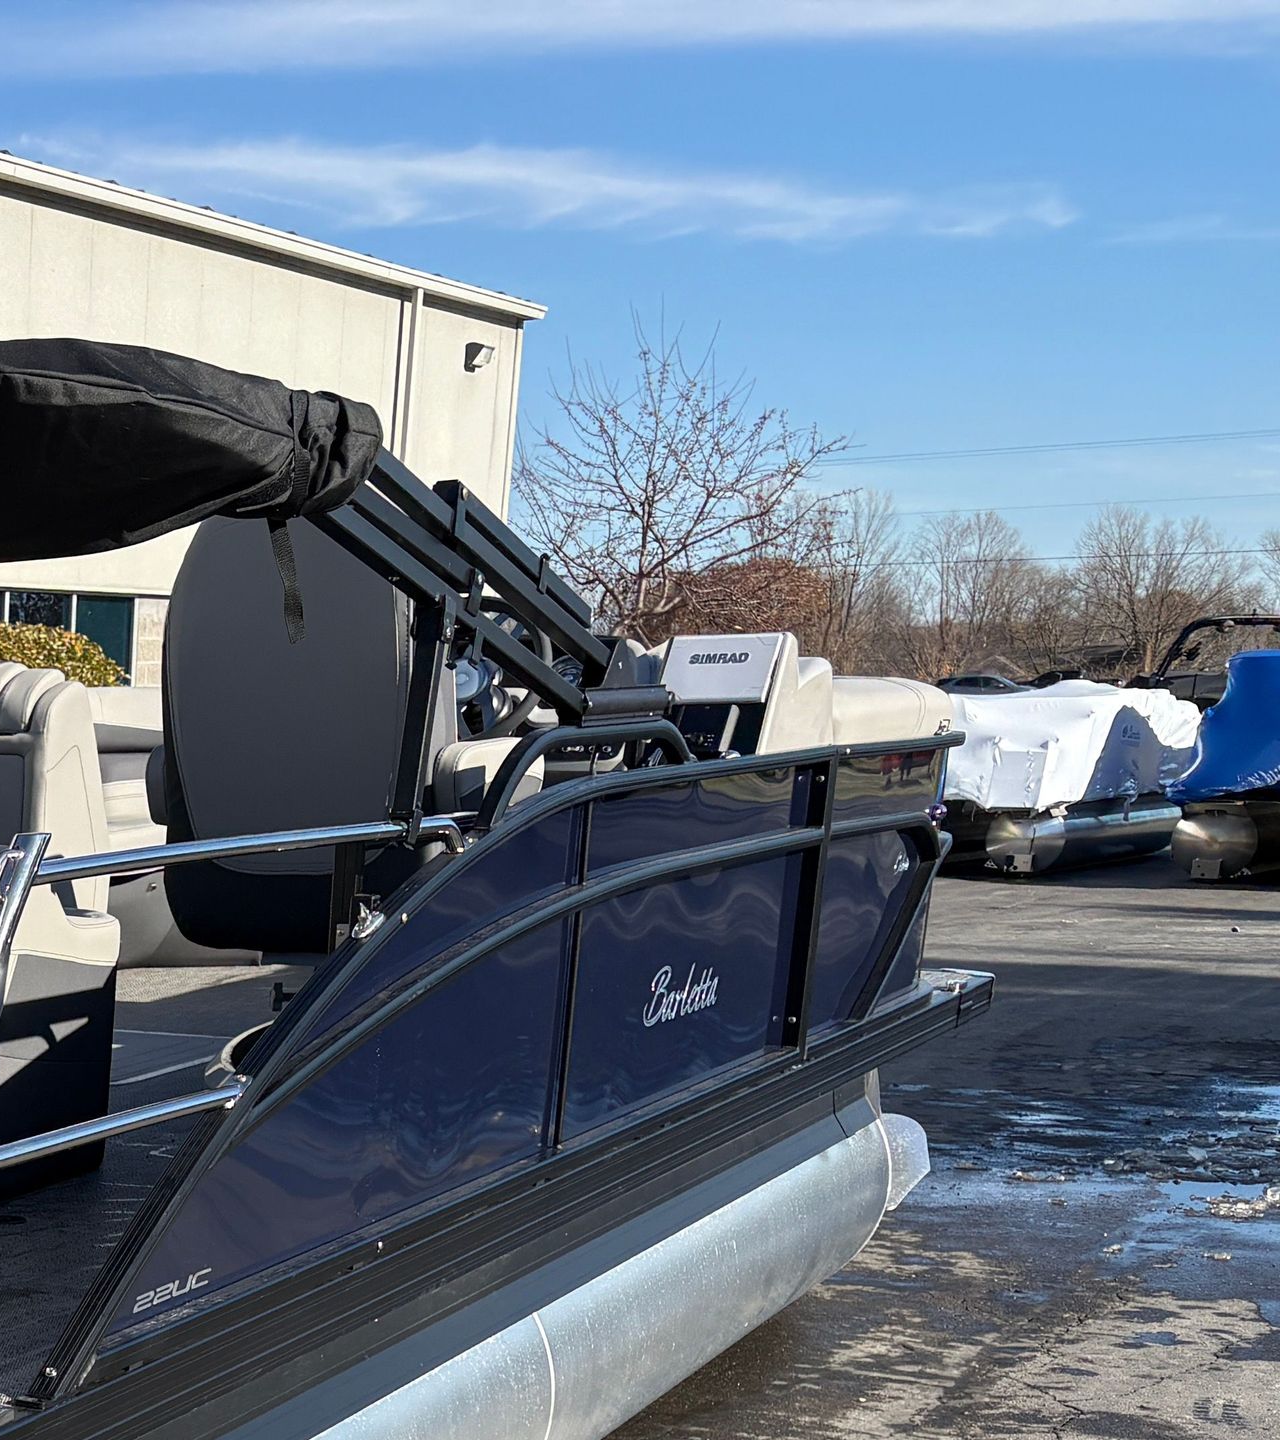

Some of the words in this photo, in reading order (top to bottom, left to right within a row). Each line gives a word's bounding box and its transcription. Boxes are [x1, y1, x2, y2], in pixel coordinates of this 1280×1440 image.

[688, 652, 750, 665] SIMRAD
[643, 962, 719, 1027] Barletta
[132, 1267, 212, 1314] 22UC
